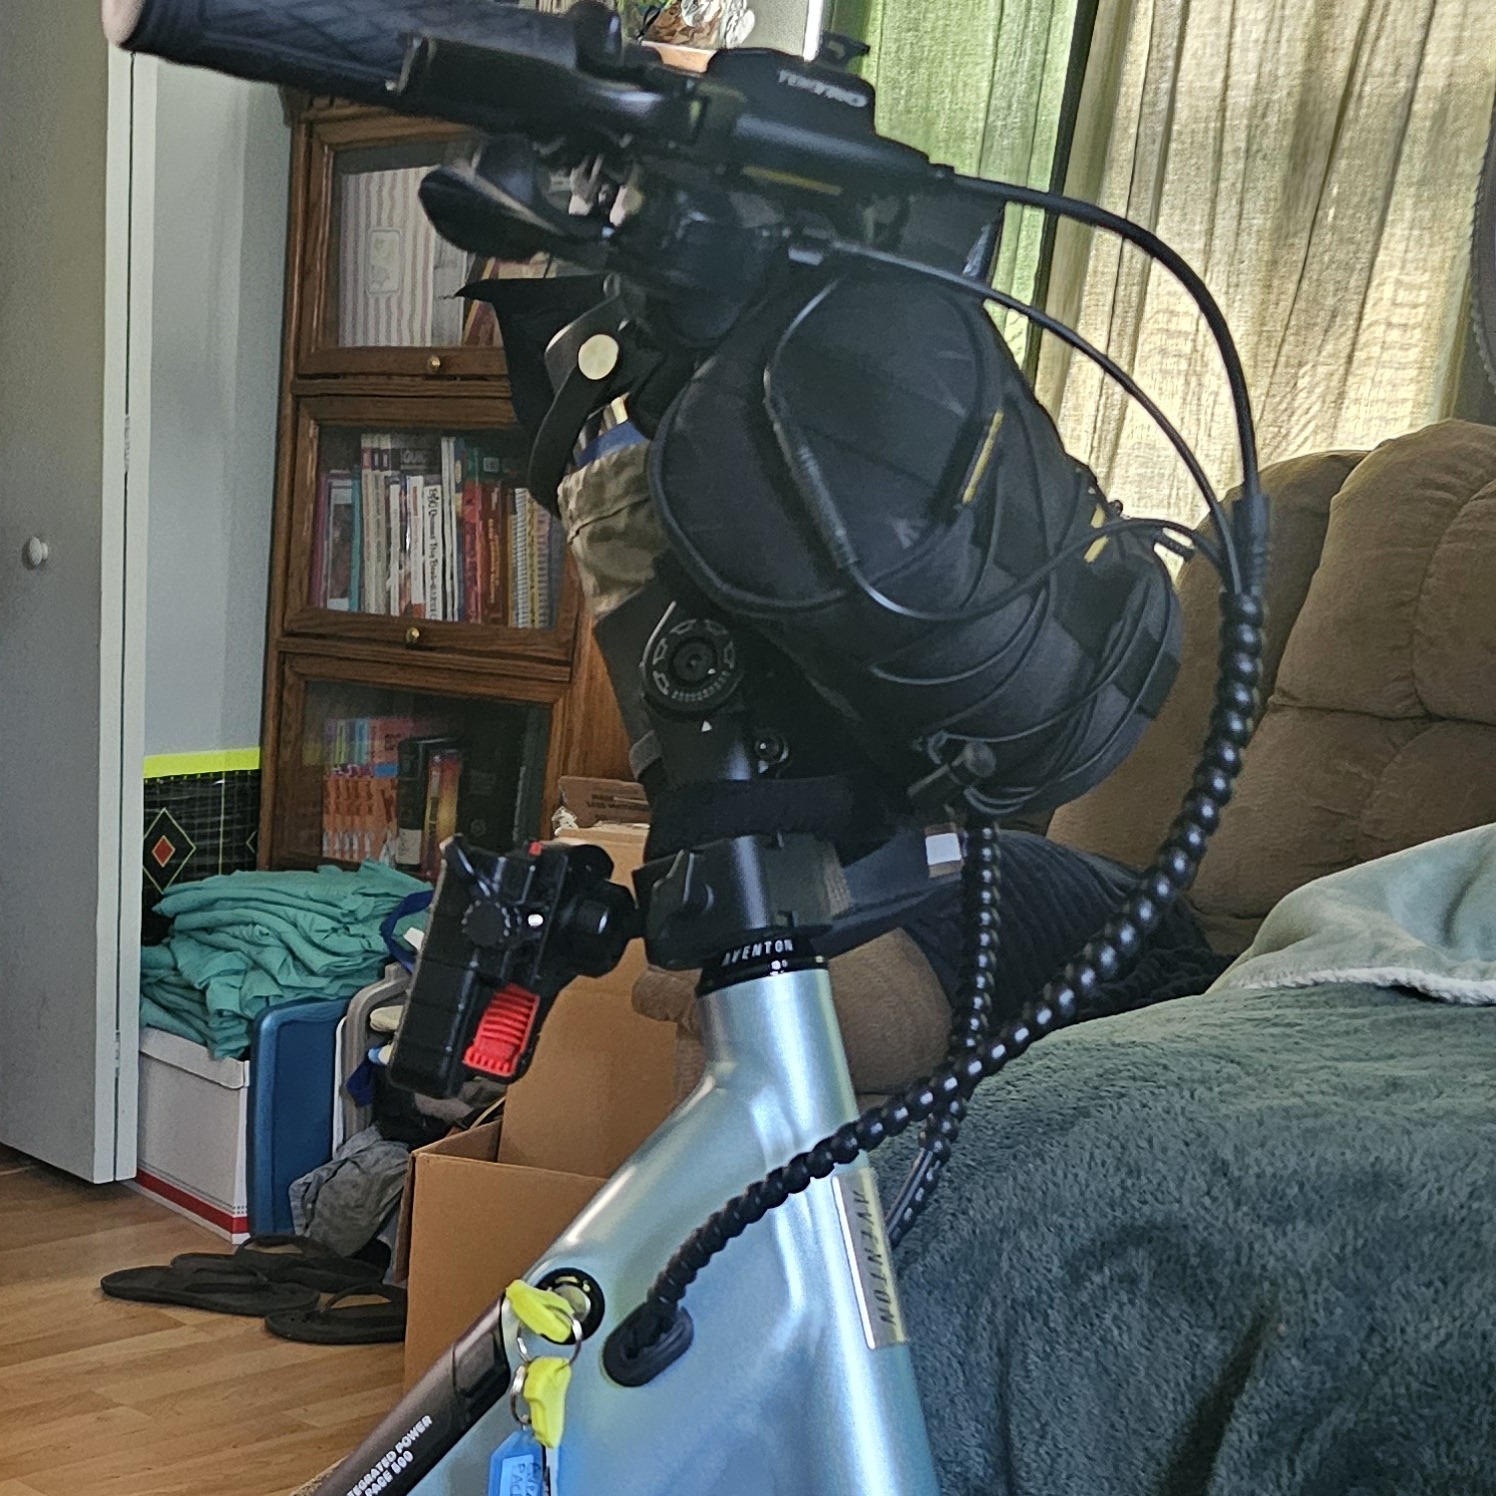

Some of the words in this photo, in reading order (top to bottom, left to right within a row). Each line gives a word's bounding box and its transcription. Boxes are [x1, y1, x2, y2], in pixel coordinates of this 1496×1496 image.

[721, 938, 794, 968] AVENTON
[851, 1189, 897, 1326] AVENTON
[395, 1415, 433, 1454] POWER
[390, 1450, 414, 1475] 500
